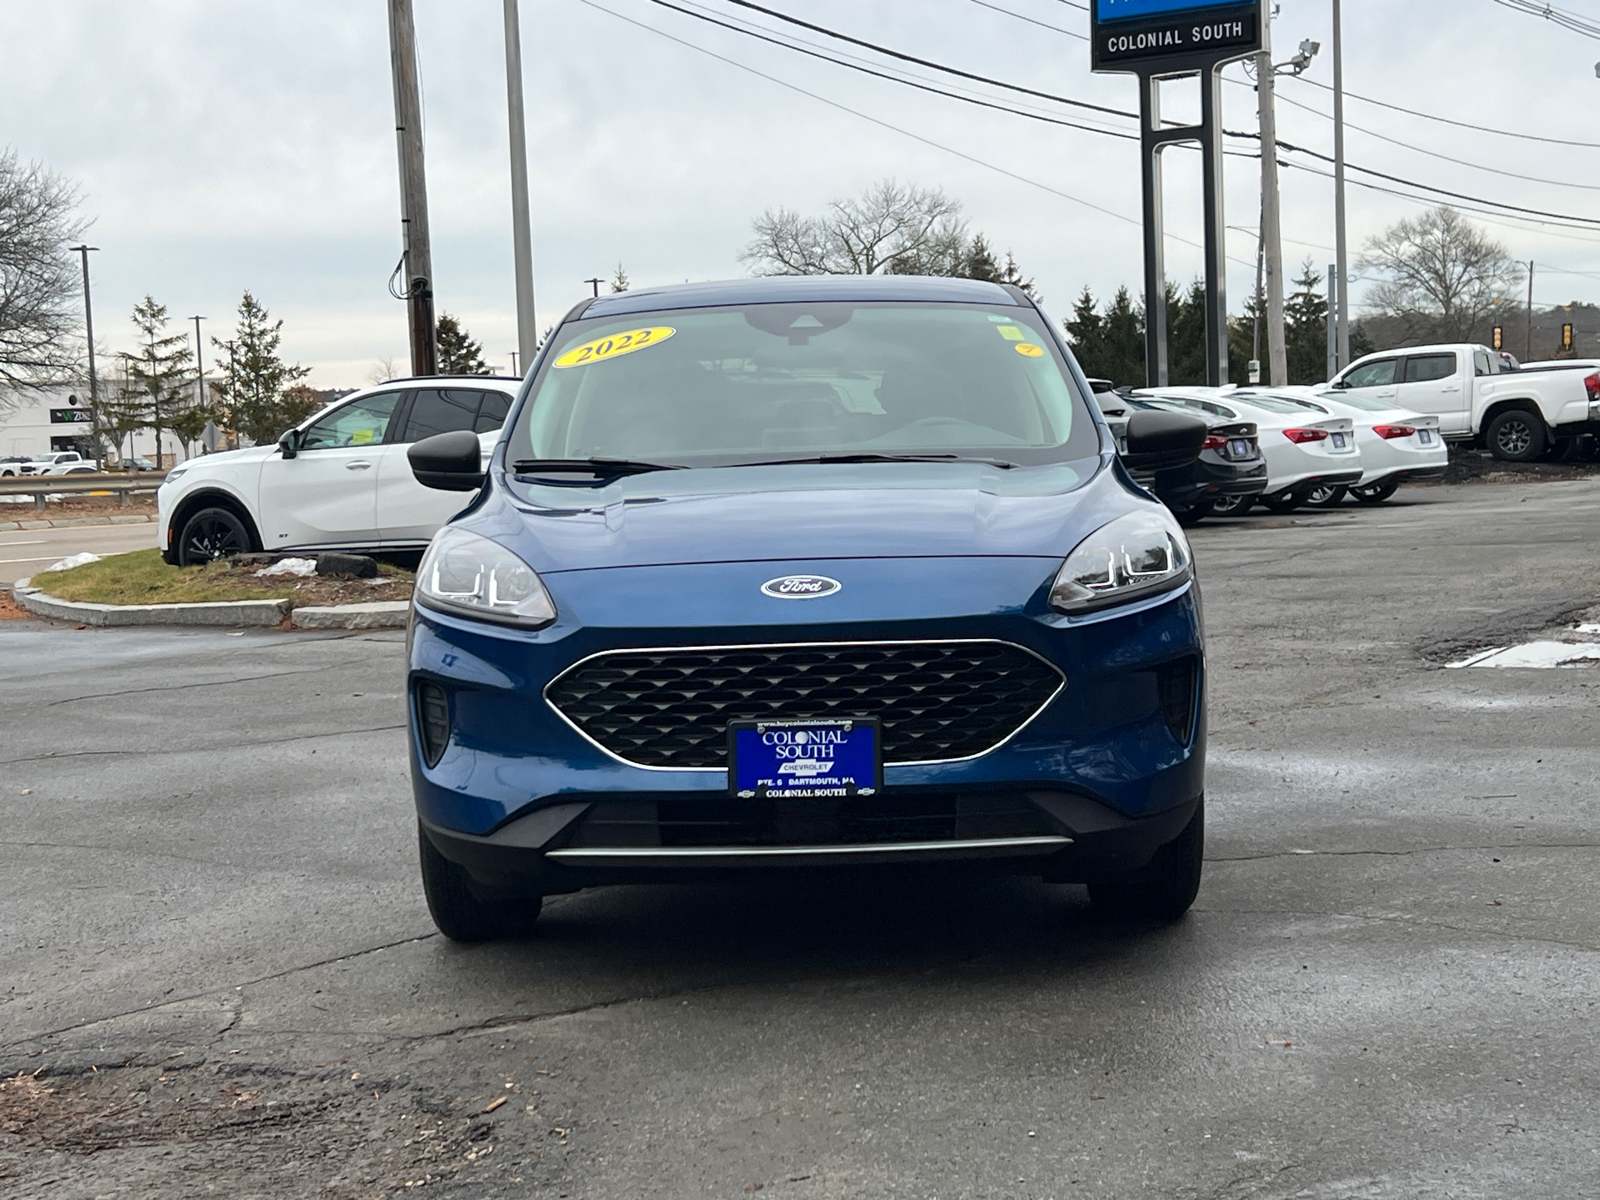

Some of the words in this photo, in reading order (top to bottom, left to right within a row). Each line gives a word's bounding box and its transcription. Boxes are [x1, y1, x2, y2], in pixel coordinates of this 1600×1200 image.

[1107, 30, 1182, 53] COLONIAL
[1191, 21, 1243, 42] SOUTH
[575, 330, 652, 364] 2022
[780, 578, 822, 593] Ford
[762, 730, 848, 746] COLONIAL
[775, 744, 835, 759] SOUTH
[783, 763, 829, 772] CHEVROLET
[777, 779, 783, 787] 6
[765, 789, 814, 798] COLONIAL
[814, 788, 847, 797] SOUTH
